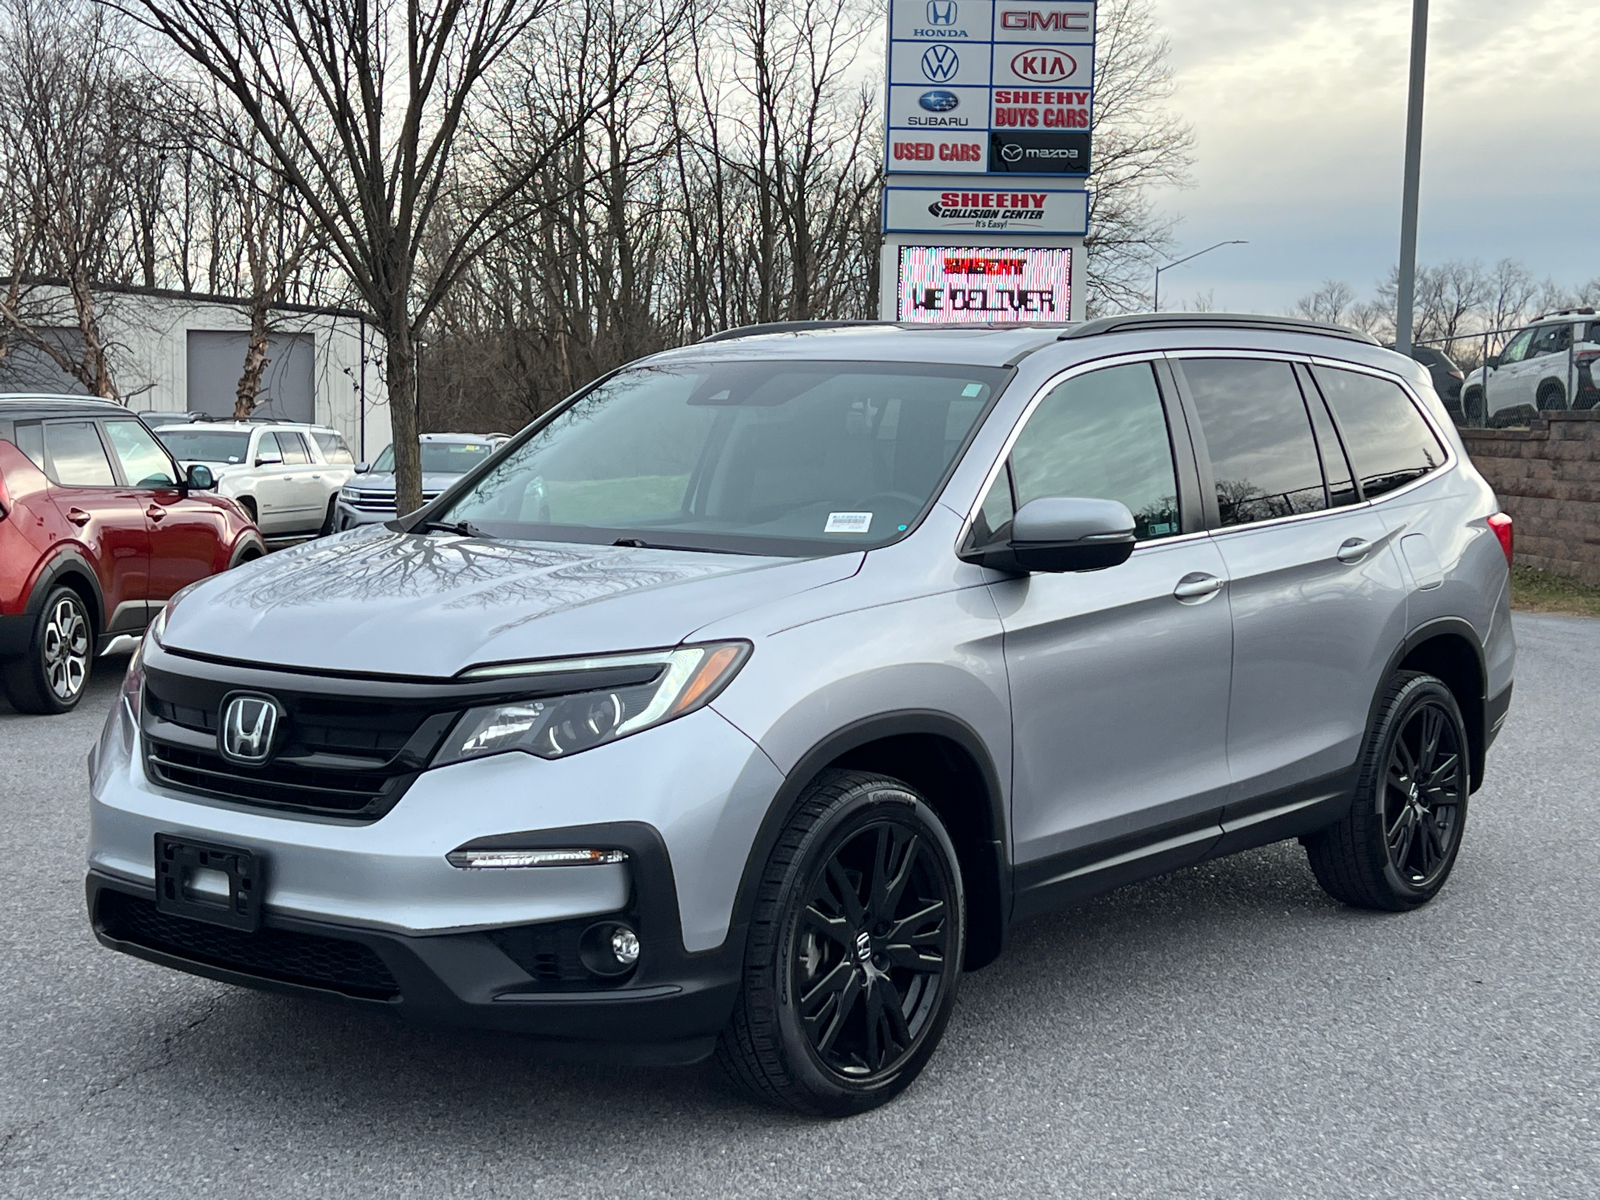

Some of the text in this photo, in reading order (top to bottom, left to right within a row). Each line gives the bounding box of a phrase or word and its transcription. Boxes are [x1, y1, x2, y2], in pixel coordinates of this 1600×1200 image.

[1001, 11, 1089, 31] GMC
[913, 29, 969, 37] HONDA
[1022, 57, 1066, 75] KIA
[994, 91, 1089, 105] SHEEHY
[907, 117, 968, 126] SUBARU
[994, 108, 1088, 128] BUYS CARS
[894, 142, 981, 162] USED CARS
[941, 193, 1048, 208] SHEEHY
[941, 209, 1045, 219] COLLISION CENTER
[975, 220, 1008, 229] It's Easy!
